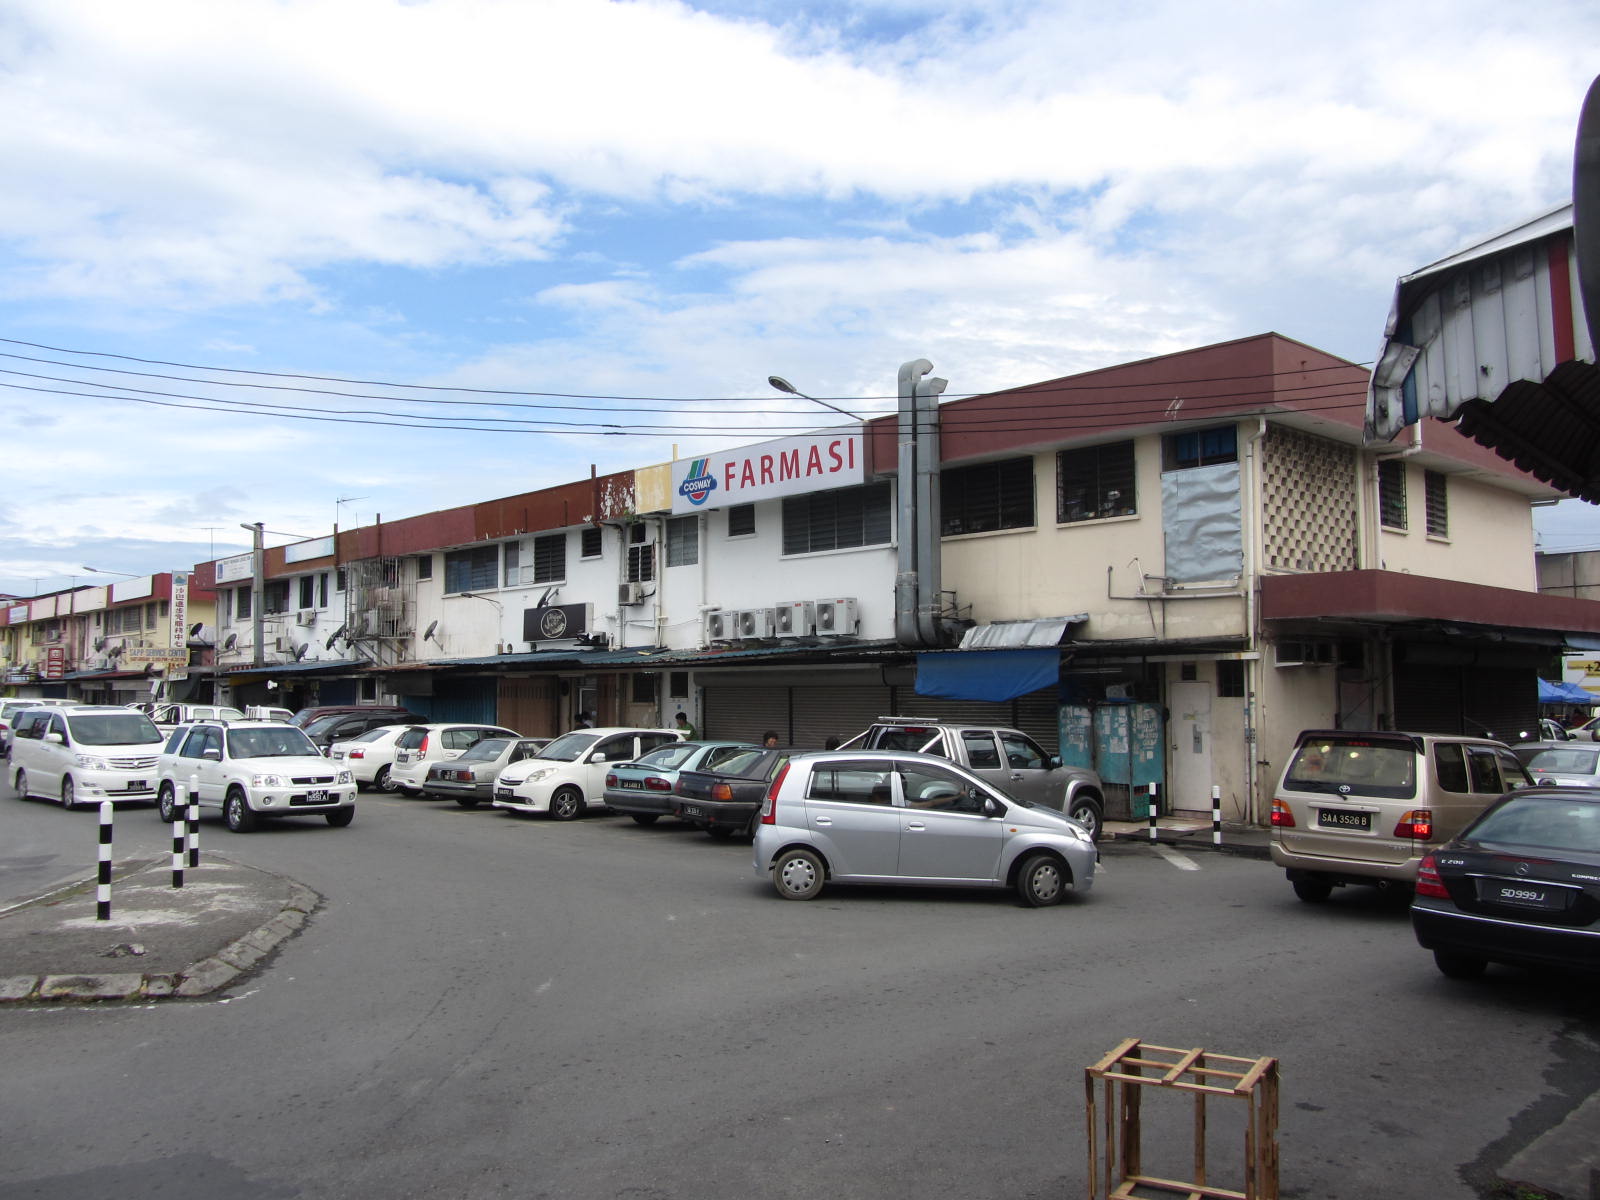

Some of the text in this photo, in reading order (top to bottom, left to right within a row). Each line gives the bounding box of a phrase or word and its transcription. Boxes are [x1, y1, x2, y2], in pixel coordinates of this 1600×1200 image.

[724, 437, 854, 492] FARMASI
[683, 478, 712, 492] COSWAY
[1322, 813, 1367, 826] SAA 3526 B
